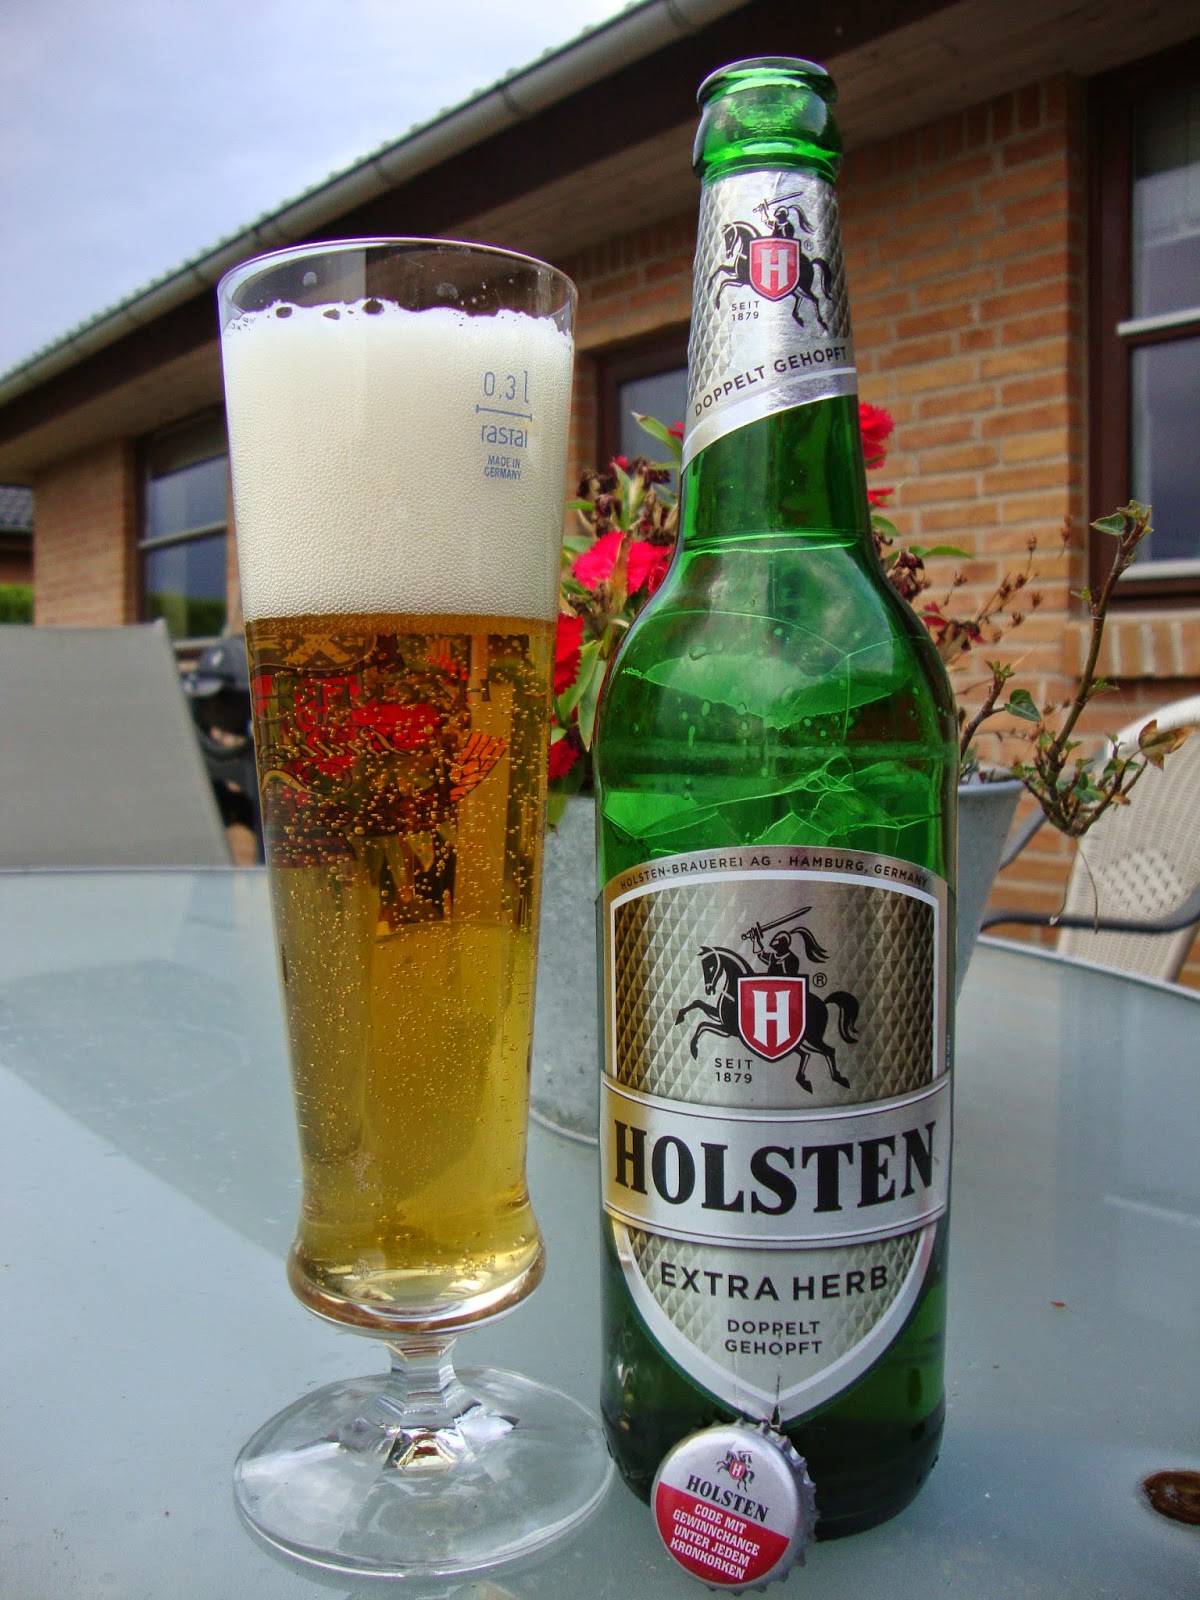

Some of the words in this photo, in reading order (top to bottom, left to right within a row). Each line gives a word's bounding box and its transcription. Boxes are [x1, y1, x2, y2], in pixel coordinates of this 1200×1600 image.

[761, 250, 788, 292] H
[731, 301, 760, 311] SEIT
[731, 311, 760, 322] 1879
[694, 365, 766, 417] DOPPELT
[774, 346, 848, 374] GEHOPFT
[481, 424, 528, 448] rastal
[484, 467, 522, 480] GERMANY
[488, 455, 510, 468] MADE
[512, 458, 521, 469] IN
[750, 856, 772, 866] AG
[789, 856, 870, 874] HAMBURG,
[874, 864, 928, 887] GERMANY
[752, 989, 791, 1048] H
[714, 1057, 754, 1070] SEIT
[715, 1071, 753, 1084] 1879
[613, 1119, 936, 1215] HOLSTEN
[660, 1261, 781, 1301] EXTRA
[792, 1265, 889, 1302] HERB
[726, 1319, 822, 1336] DOPPELT
[724, 1339, 824, 1355] GEHOPFT
[685, 1474, 770, 1523] HOLSTEN
[672, 1509, 761, 1557] GEWINNCHANCE
[694, 1504, 724, 1524] CODE
[723, 1516, 748, 1535] MIT
[669, 1537, 746, 1581] KRONKORKEN
[673, 1524, 711, 1549] UNTER
[710, 1542, 751, 1568] JEDEM
